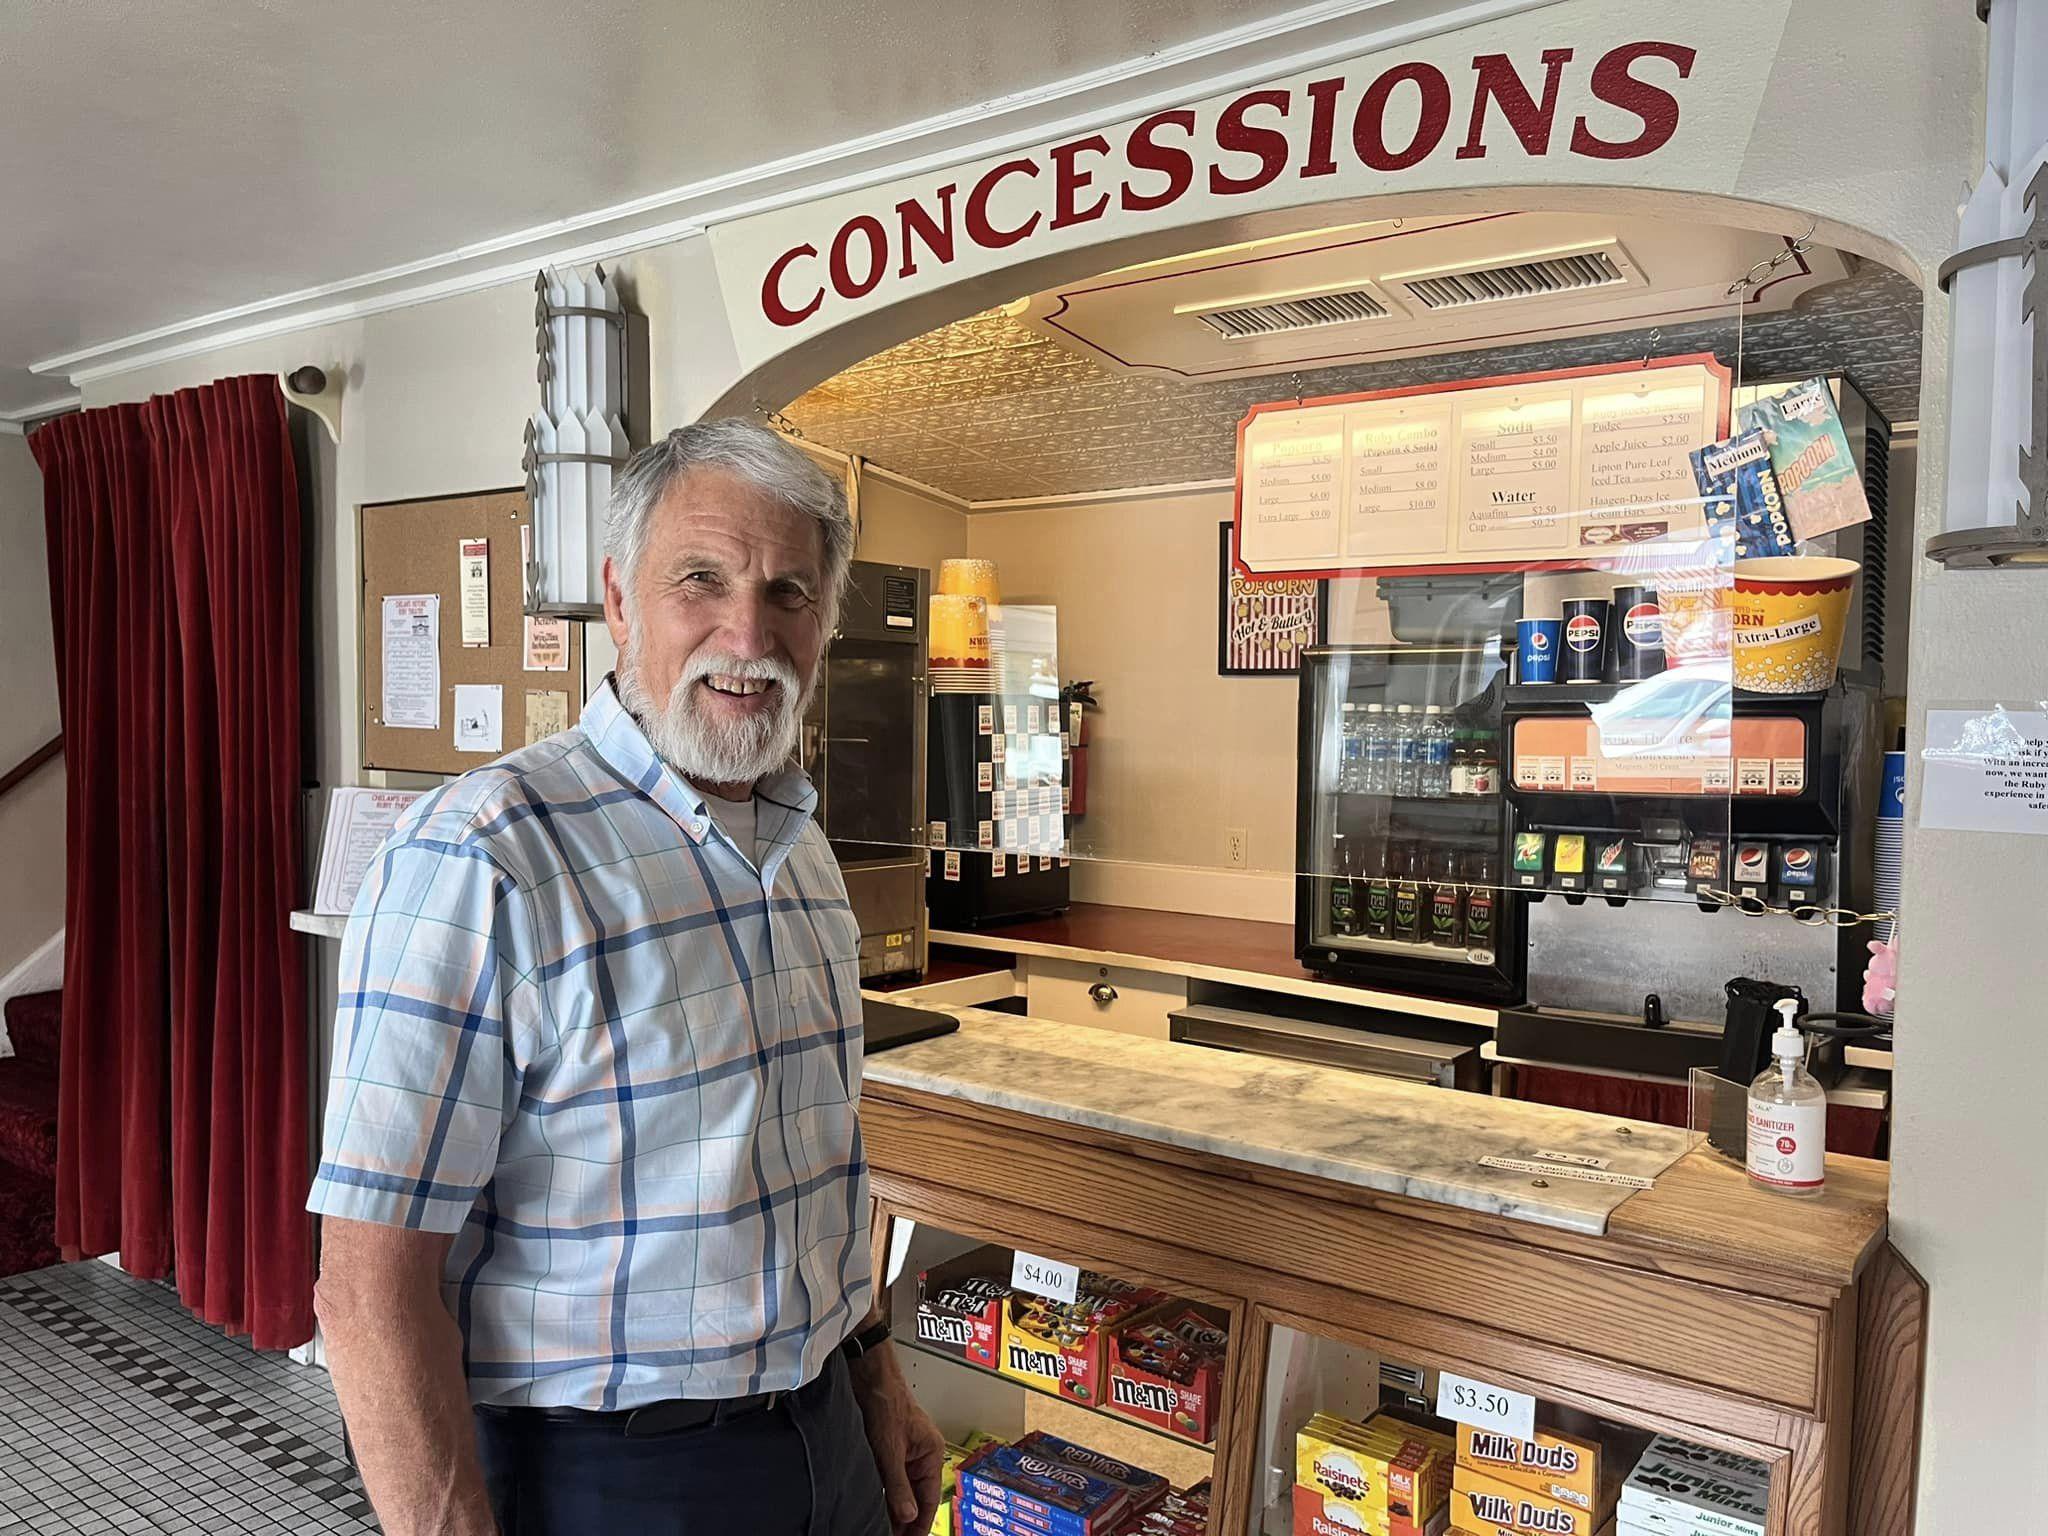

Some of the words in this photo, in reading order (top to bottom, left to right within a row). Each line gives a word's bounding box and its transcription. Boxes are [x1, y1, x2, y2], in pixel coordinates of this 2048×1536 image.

[760, 41, 1697, 327] CONCESSIONS
[1782, 393, 1823, 416] Large
[1496, 421, 1534, 434] Soda
[1592, 420, 1622, 433] Fudge
[1661, 412, 1690, 424] $2.50
[1471, 440, 1496, 451] Small
[1592, 441, 1621, 453] Apple
[1623, 438, 1648, 451] Juice
[1661, 434, 1689, 446] $2.00
[1471, 452, 1507, 464] Medium
[1591, 461, 1623, 475] Lipton
[1625, 459, 1647, 471] Pure
[1649, 455, 1673, 468] Leaf
[1707, 443, 1763, 473] Medium
[1777, 434, 1835, 495] POPCORN
[1470, 466, 1496, 477] Large
[1614, 473, 1631, 485] Tea
[1659, 468, 1688, 480] $2.50
[1491, 490, 1537, 503] Water
[1656, 490, 1671, 501] Ice
[1470, 507, 1509, 520] Aquafina
[1590, 508, 1621, 521] Cream
[1659, 503, 1688, 514] $2.50
[1757, 468, 1792, 547] POPCORN
[1468, 522, 1487, 533] Cup
[1231, 577, 1316, 597] POPCORN
[1667, 583, 1703, 593] Small
[1233, 620, 1256, 642] Hot
[1258, 617, 1268, 632] &
[1270, 608, 1314, 630] Buttery
[1626, 620, 1662, 630] PEPS
[1736, 620, 1817, 644] Extra-Large
[1568, 629, 1599, 638] PEPSI
[1526, 653, 1551, 663] pepsi
[2034, 749, 2042, 757] if
[1984, 758, 2006, 767] With
[2024, 771, 2048, 779] want
[2004, 780, 2019, 788] the
[2021, 780, 2047, 791] Ruby
[1984, 790, 2034, 799] experience
[2036, 791, 2045, 799] in
[1786, 870, 1808, 878] pepsi
[1755, 1116, 1795, 1132] SANITIZER
[1023, 1263, 1063, 1289] $4.00
[974, 1321, 993, 1335] SHARE
[977, 1332, 989, 1341] SIZE
[1067, 1355, 1089, 1370] SHARE
[1071, 1366, 1083, 1377] SIZE
[1179, 1390, 1202, 1405] SHARE
[1453, 1384, 1509, 1417] $3.50
[1184, 1400, 1197, 1412] SIZE
[1471, 1431, 1518, 1462] Milk
[1521, 1440, 1579, 1471] Duds
[1059, 1446, 1091, 1465] RED
[1089, 1456, 1132, 1480] VINES
[1712, 1458, 1770, 1478] Mint
[1015, 1455, 1046, 1475] RED
[1044, 1467, 1090, 1491] VINES
[1312, 1460, 1371, 1492] Raisinets
[1390, 1472, 1412, 1486] MILK
[1637, 1462, 1753, 1499] Junior
[972, 1478, 991, 1493] RED
[989, 1484, 1007, 1501] VINES
[1694, 1489, 1767, 1516] Mints
[1468, 1492, 1514, 1526] Milk
[1517, 1501, 1575, 1534] Duds
[1696, 1512, 1734, 1529] Junior
[1735, 1524, 1759, 1536] Mints
